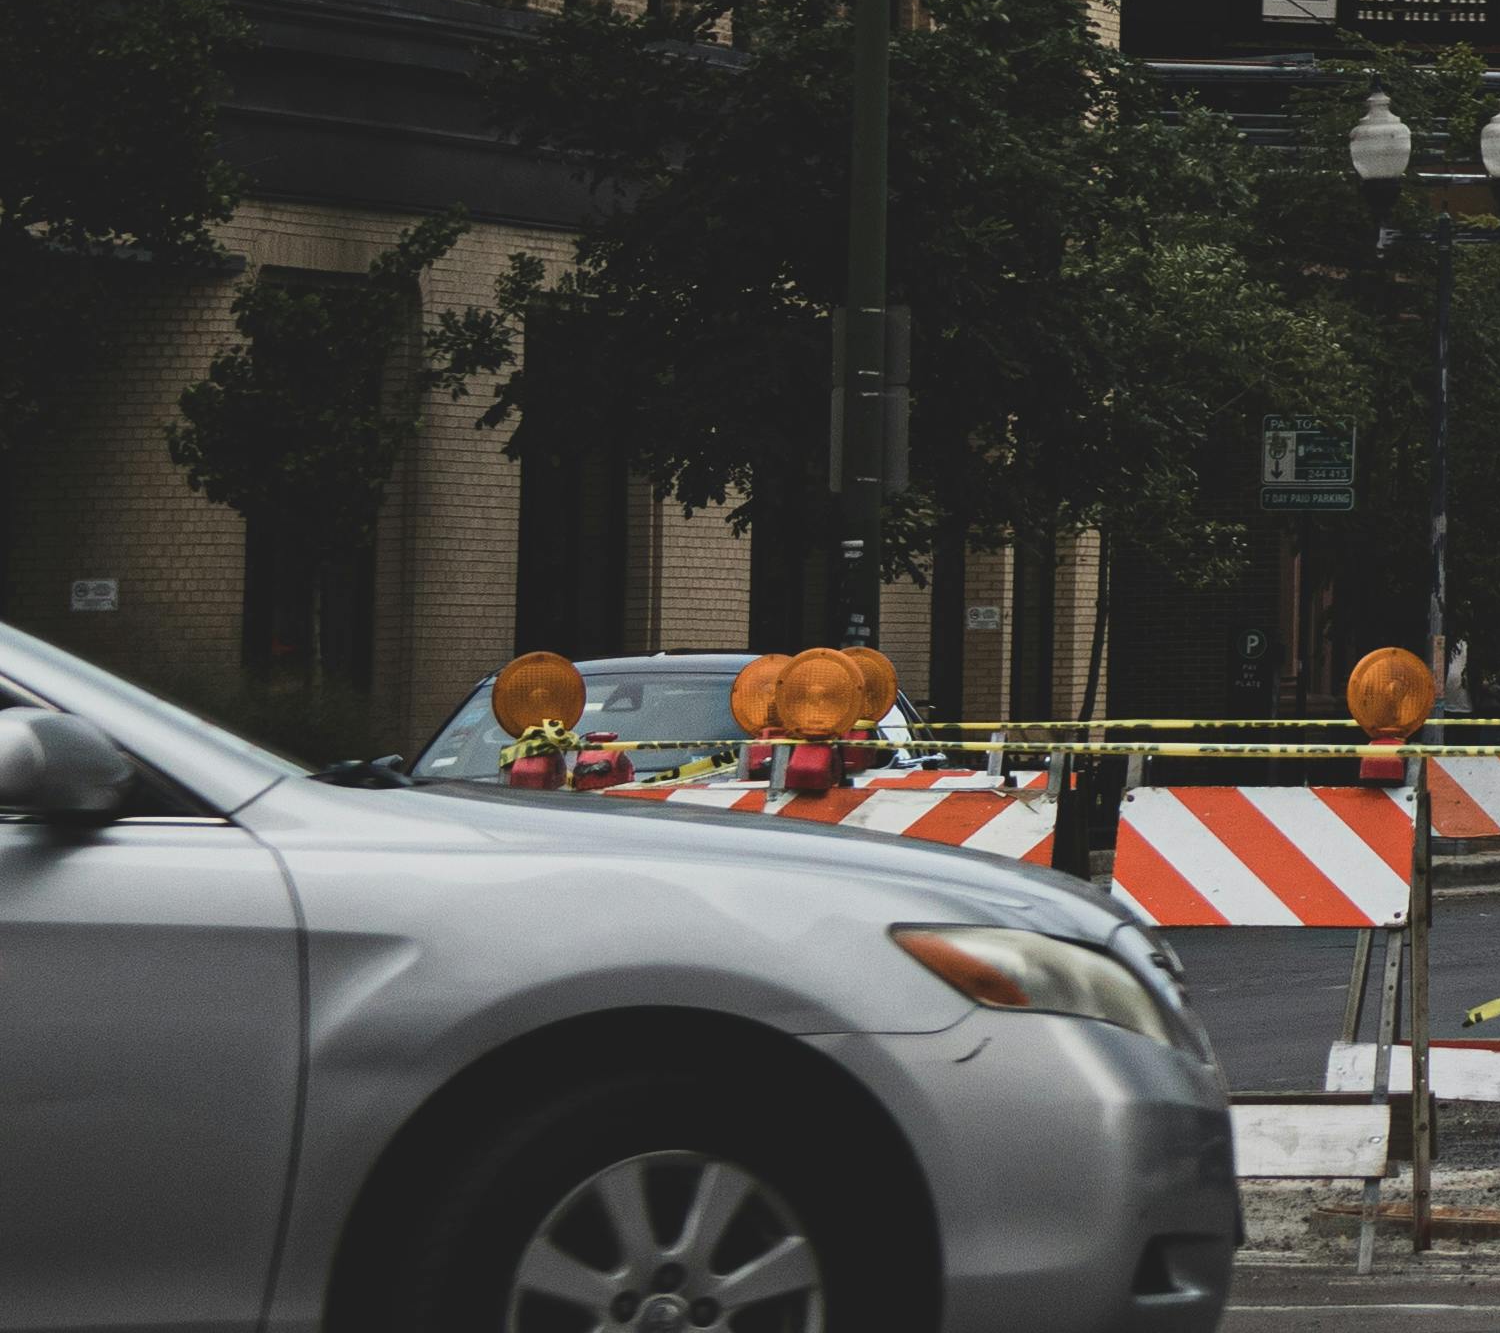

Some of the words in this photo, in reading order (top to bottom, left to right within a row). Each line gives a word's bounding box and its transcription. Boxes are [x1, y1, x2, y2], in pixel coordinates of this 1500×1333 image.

[1296, 419, 1312, 429] TO
[1308, 469, 1326, 478] 244
[1329, 469, 1347, 478] 413
[1272, 493, 1287, 503] DAY
[1290, 493, 1310, 503] PAID
[1313, 493, 1350, 503] PARKING
